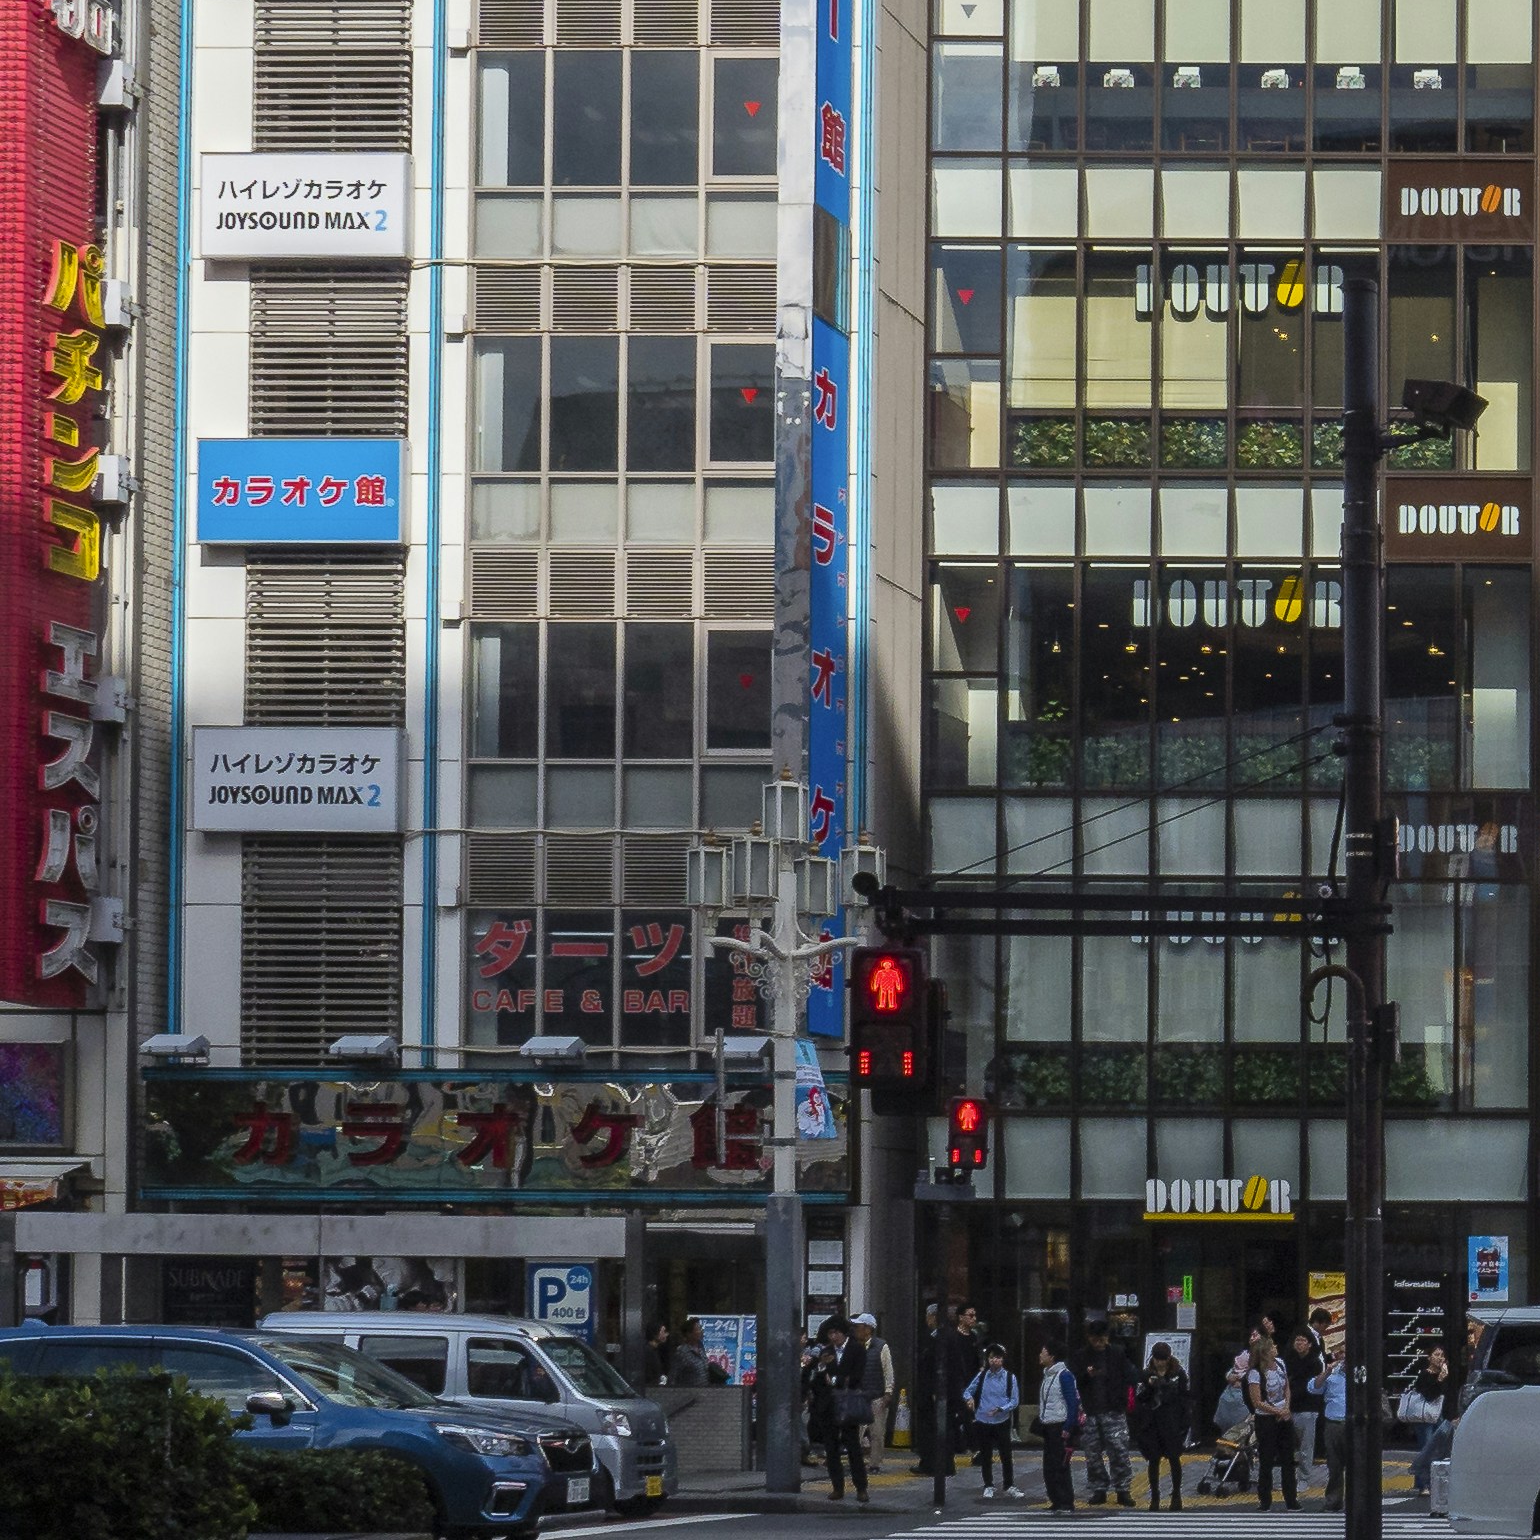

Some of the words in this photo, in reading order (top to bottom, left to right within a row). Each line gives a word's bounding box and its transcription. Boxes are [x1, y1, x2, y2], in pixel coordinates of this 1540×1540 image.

[1400, 183, 1523, 219] DOUTOR
[43, 239, 106, 583] パチンコ
[35, 620, 100, 987] エスパス
[475, 919, 684, 978] ダーツ
[472, 990, 564, 1013] CAFE
[581, 990, 602, 1013] &
[625, 990, 688, 1013] BAR
